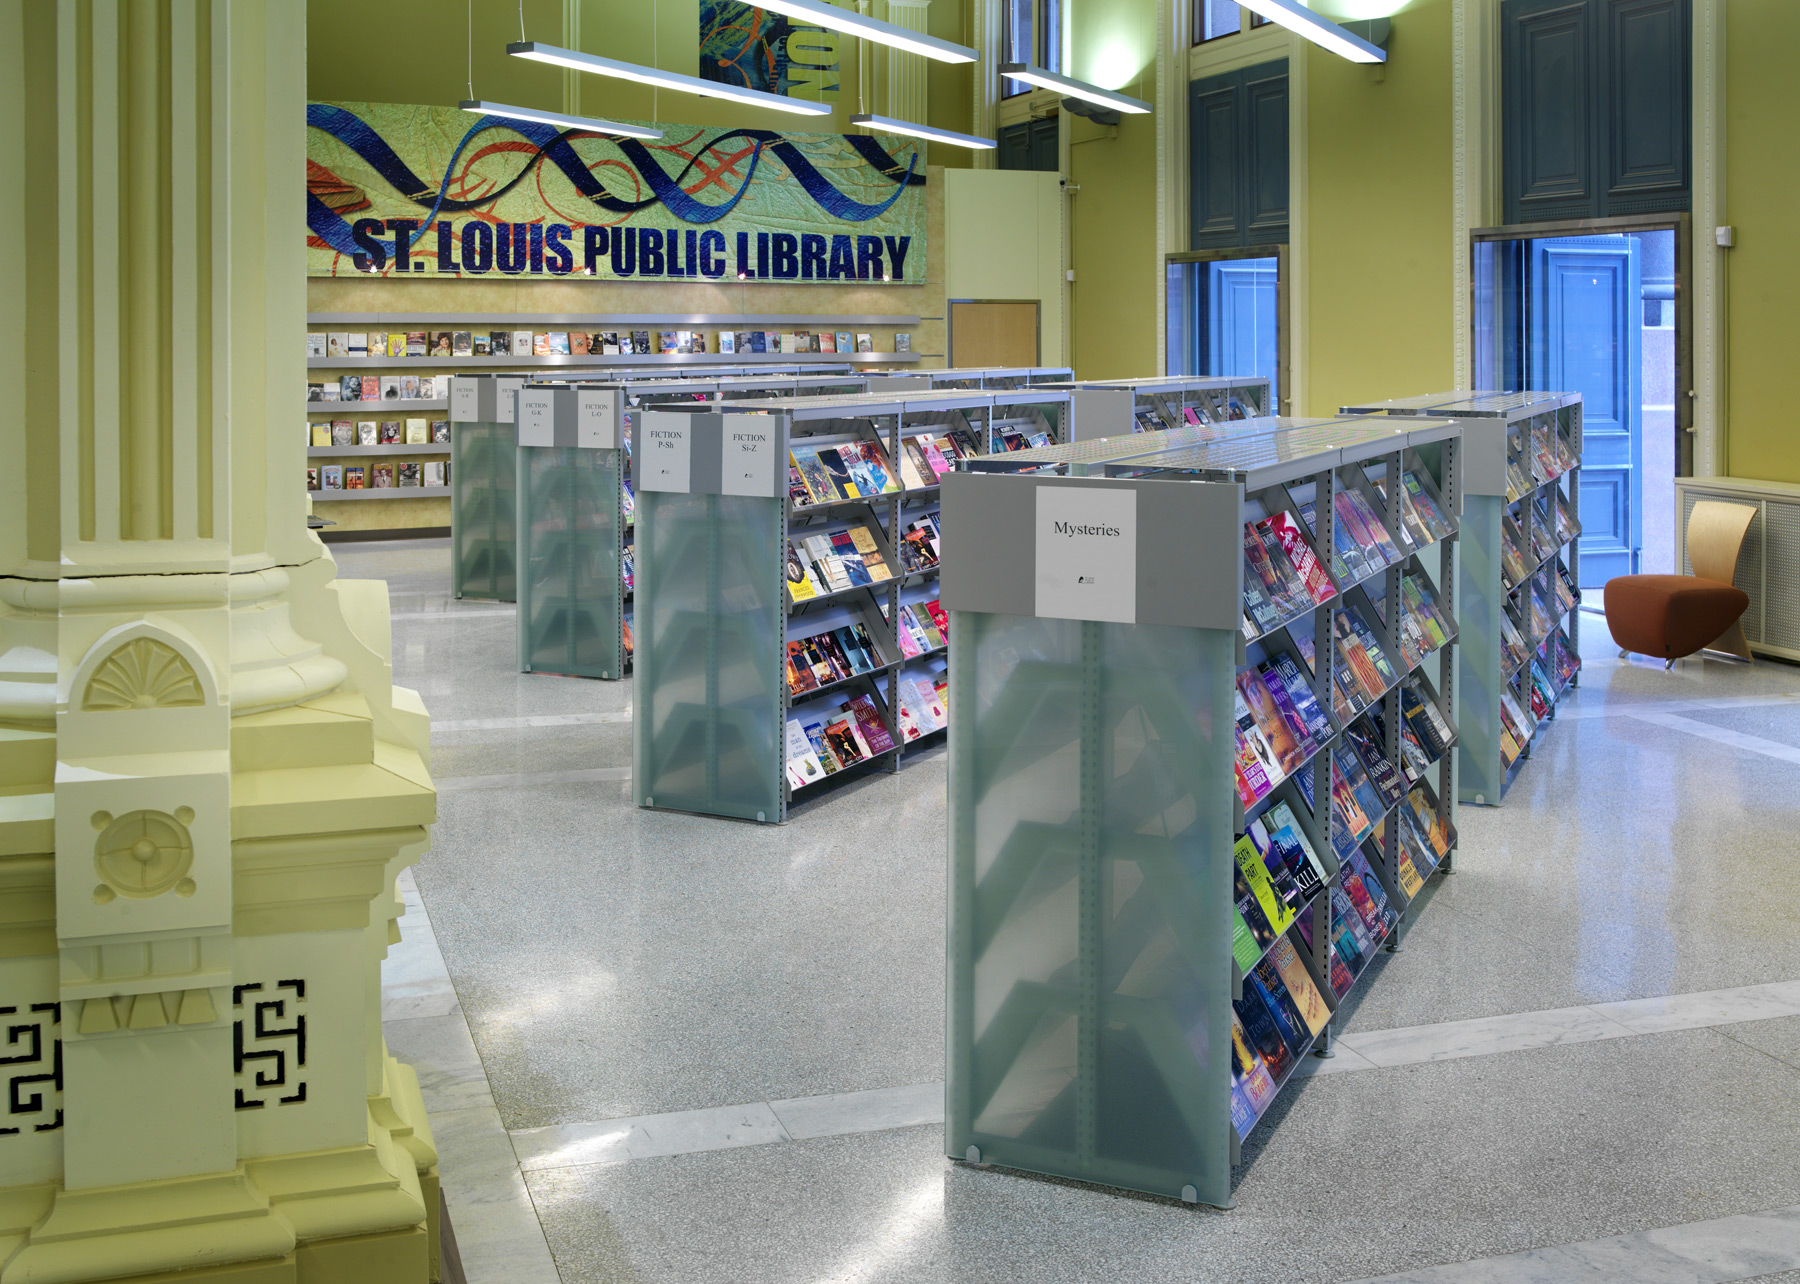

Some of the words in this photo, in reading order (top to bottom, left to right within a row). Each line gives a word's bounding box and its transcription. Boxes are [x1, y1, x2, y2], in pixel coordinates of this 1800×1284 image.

[352, 218, 425, 273] ST.
[437, 220, 573, 275] LOUIS
[584, 225, 726, 279] PUBLIC
[736, 231, 912, 281] LIBRARY
[650, 430, 682, 439] FICTION
[733, 433, 766, 442] FICTION
[658, 441, 674, 449] P-Sh
[741, 444, 757, 452] Si-Z
[1054, 521, 1120, 538] Mysteries
[856, 707, 879, 721] SMITH
[1367, 750, 1380, 763] IAN
[1369, 757, 1392, 778] RANKIN
[1275, 834, 1299, 854] FINAL
[1235, 847, 1252, 867] DEATH
[1244, 863, 1259, 881] PART
[1293, 866, 1320, 893] KILL
[1368, 921, 1383, 939] BONES
[1277, 949, 1295, 972] Parker
[1261, 974, 1279, 994] Parker
[1236, 991, 1258, 1013] DARK
[1249, 1013, 1271, 1037] TOWN
